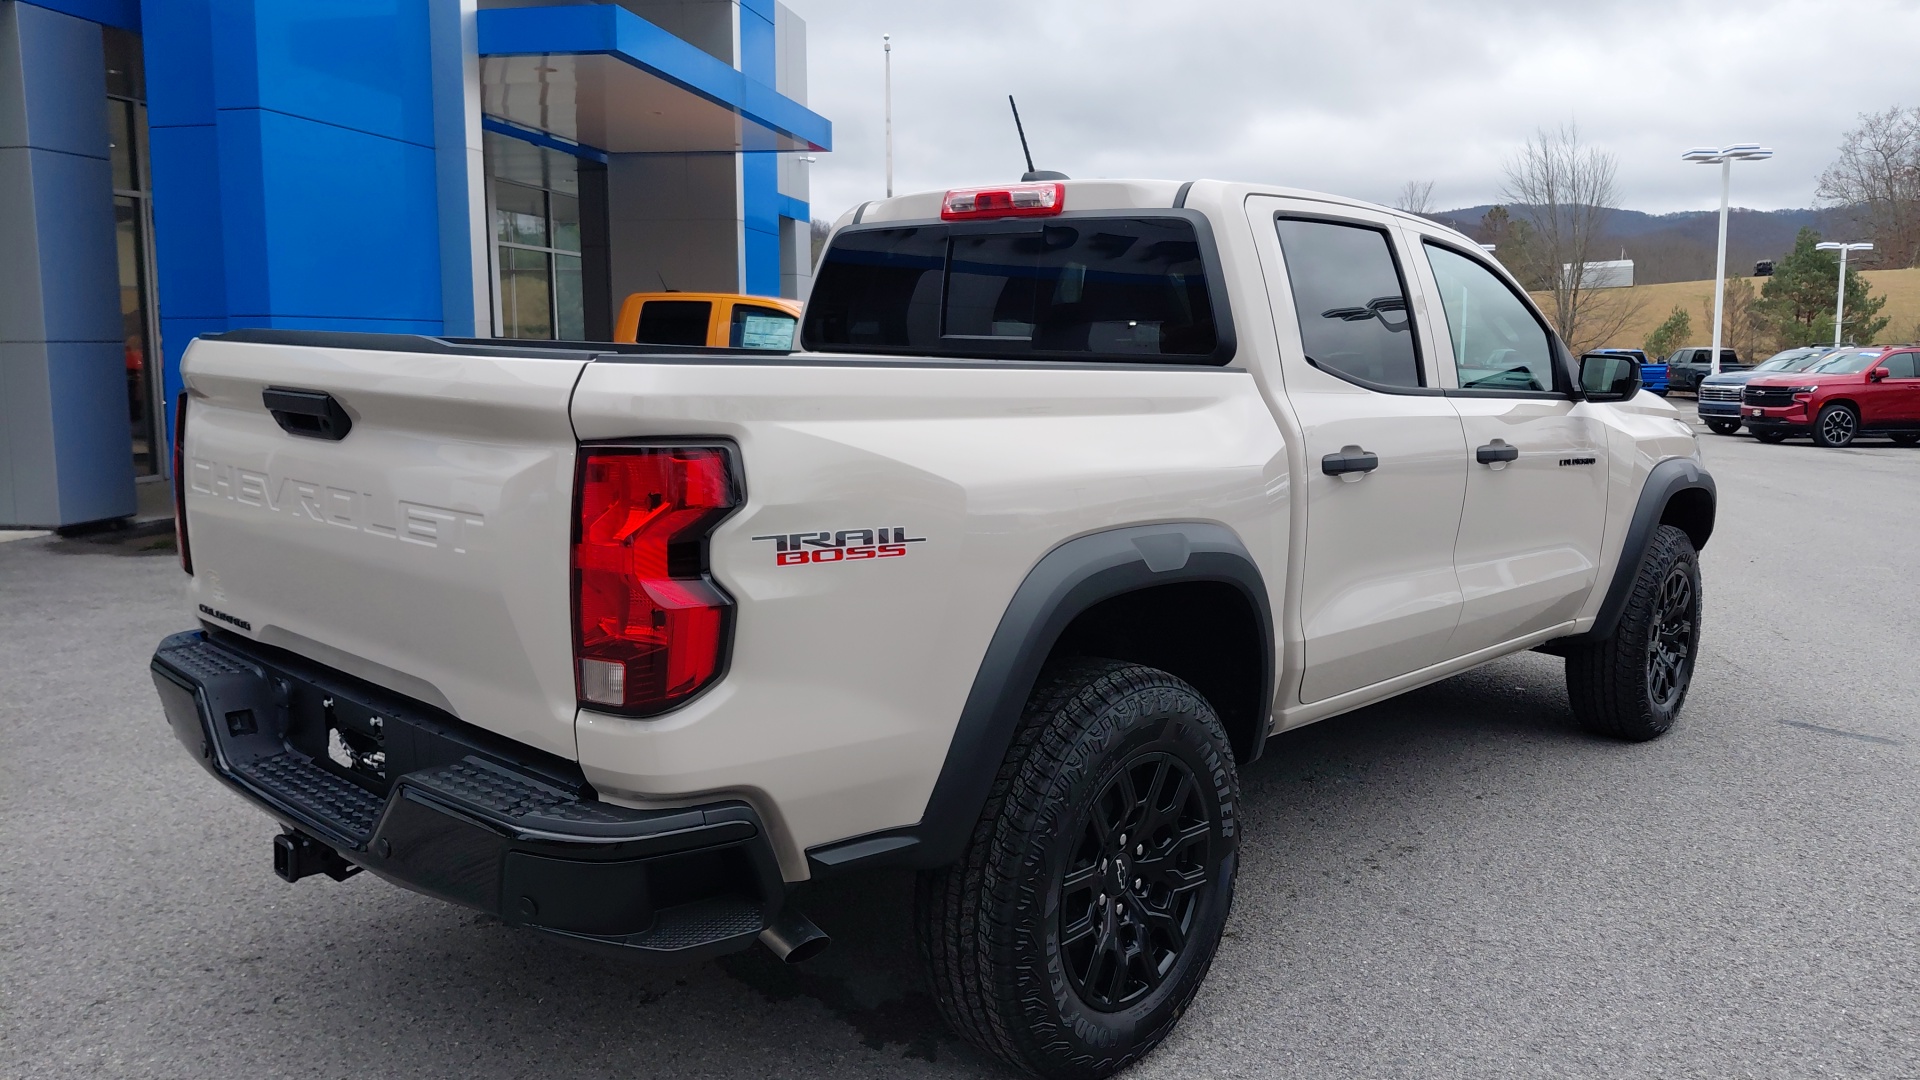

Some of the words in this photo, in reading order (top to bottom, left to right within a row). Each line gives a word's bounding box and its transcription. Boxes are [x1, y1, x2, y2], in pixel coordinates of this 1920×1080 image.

[190, 457, 484, 554] CHEVROLET
[752, 526, 927, 552] TRAIL
[776, 543, 906, 567] BOSS
